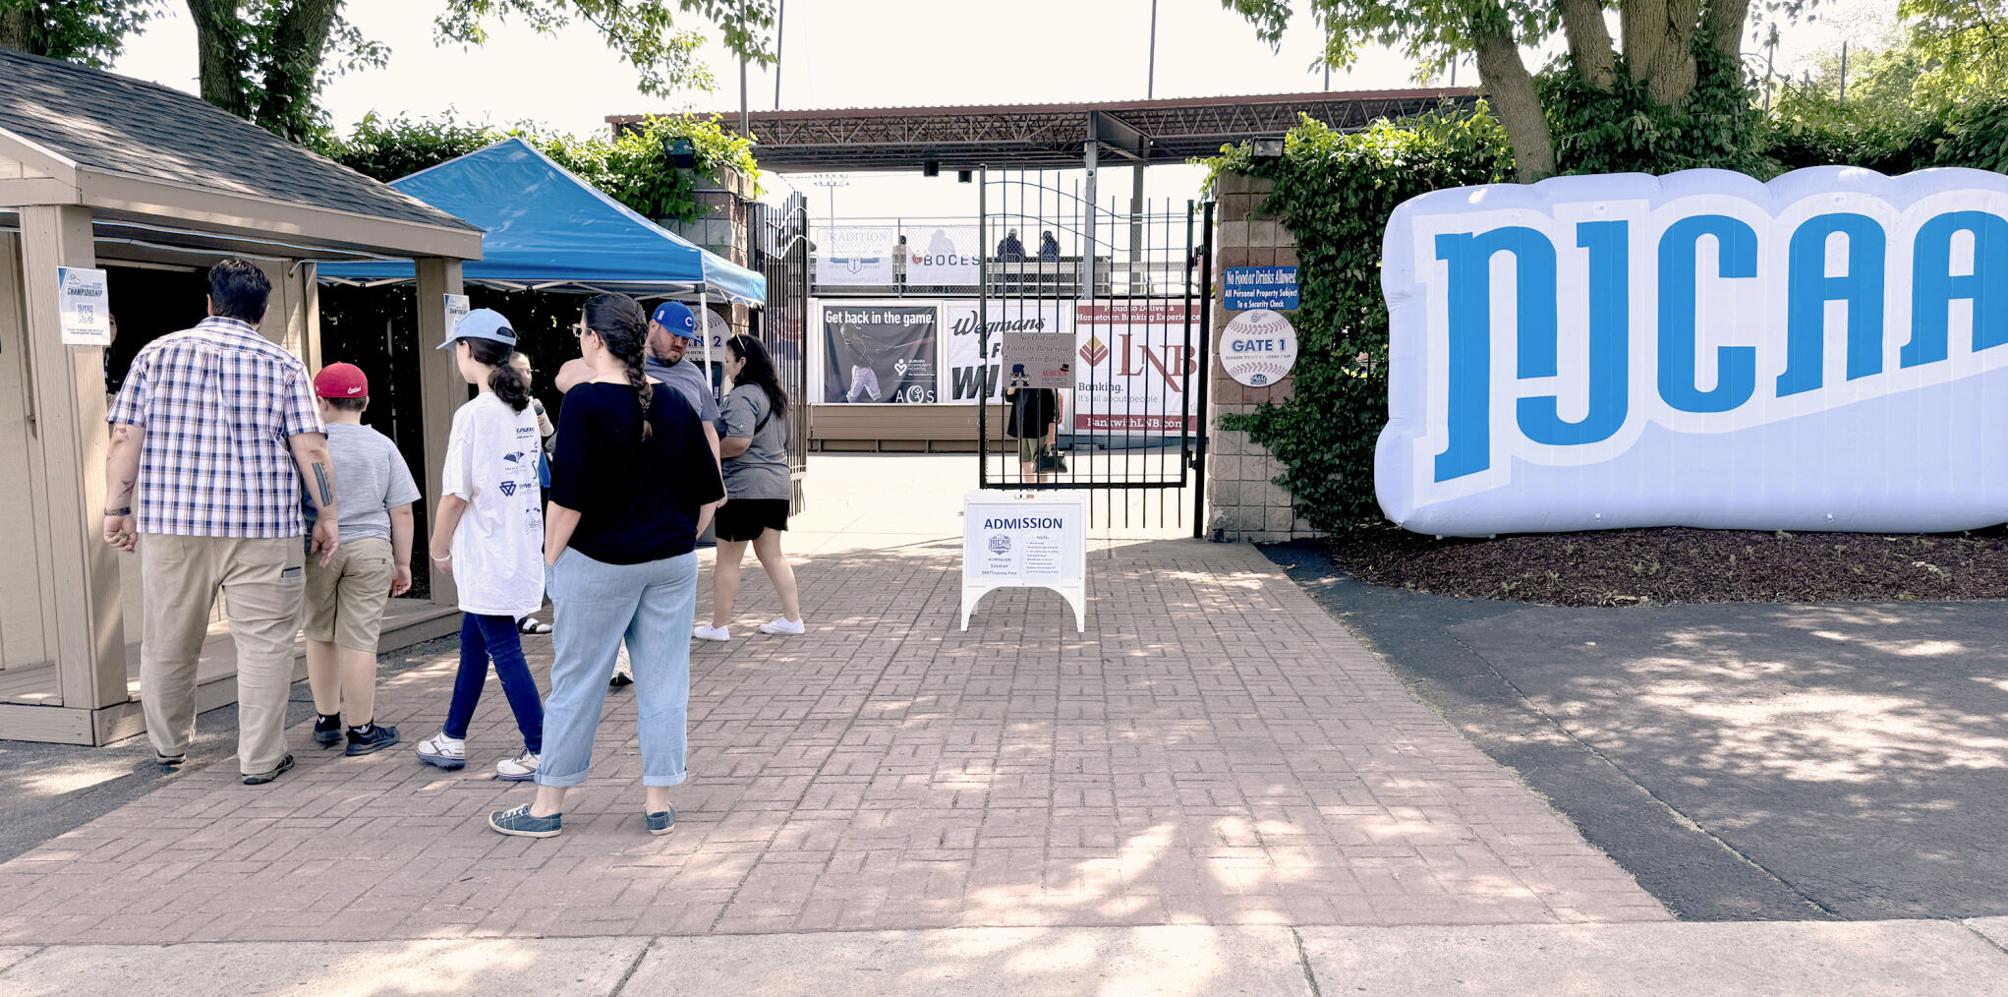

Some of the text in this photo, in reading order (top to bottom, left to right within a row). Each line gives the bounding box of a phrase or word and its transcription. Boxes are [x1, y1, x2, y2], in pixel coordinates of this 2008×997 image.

[924, 254, 980, 266] BOCES
[1226, 270, 1234, 284] No
[1235, 270, 1248, 284] Food
[1255, 269, 1274, 284] Drinks
[1275, 269, 1297, 284] Allowed
[1233, 289, 1255, 297] Personal
[1256, 288, 1278, 299] Property
[1279, 287, 1298, 298] Subject
[1237, 300, 1243, 308] To
[1249, 300, 1268, 309] Security
[1270, 300, 1285, 308] Check
[826, 310, 935, 327] Get back in the game.
[1156, 312, 1200, 322] Experiece
[951, 310, 1046, 341] Wegmans
[713, 335, 721, 347] 2
[1232, 339, 1286, 352] GATE 1
[1434, 210, 2008, 483] NJCAA
[1117, 333, 1198, 393] LNB
[1078, 381, 1124, 394] Banking.
[1087, 416, 1183, 428] BankwihLNB.com
[983, 517, 1063, 530] ADMISSION
